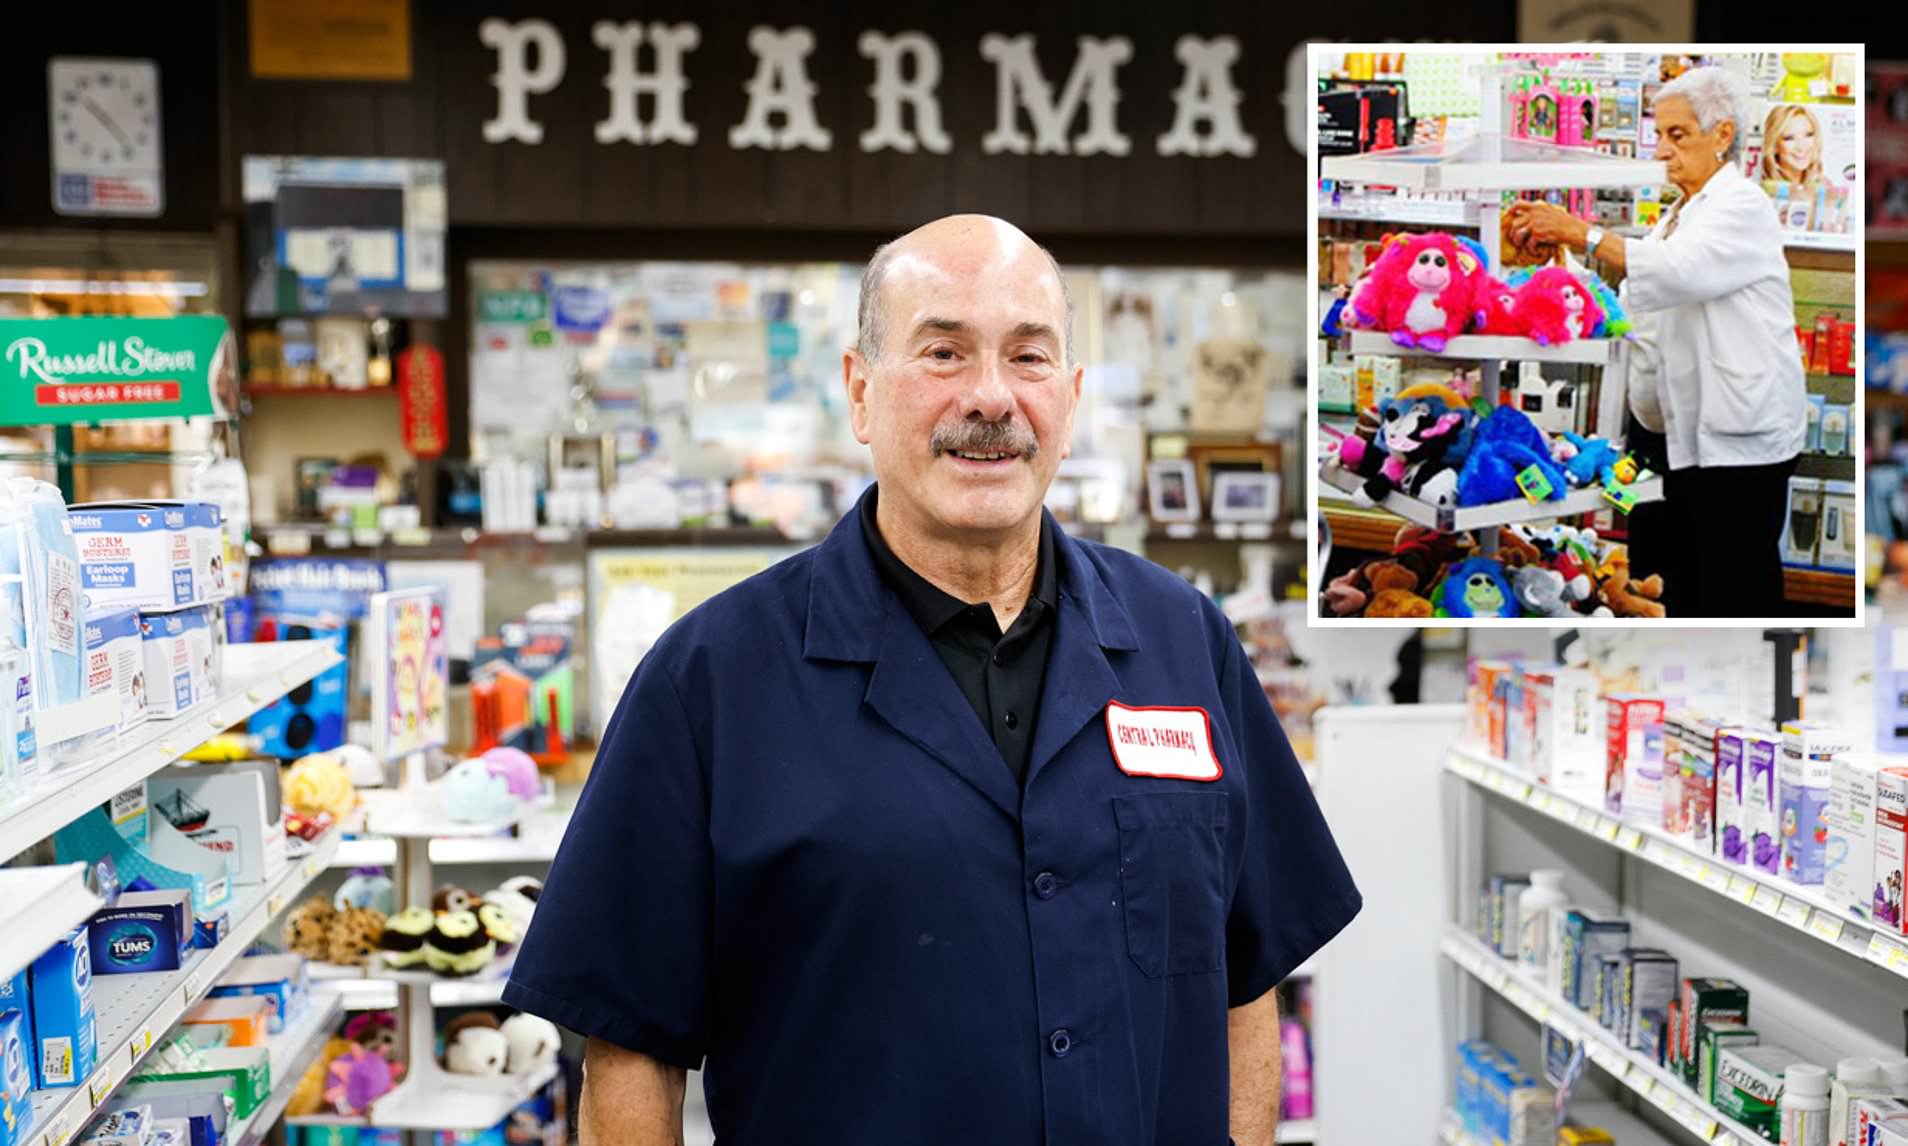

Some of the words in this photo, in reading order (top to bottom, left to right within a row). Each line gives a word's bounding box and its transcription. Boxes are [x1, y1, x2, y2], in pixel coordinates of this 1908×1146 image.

[6, 336, 122, 384] Russell
[120, 335, 196, 377] Stover
[56, 385, 119, 403] SUGAR
[123, 383, 164, 401] FREE
[88, 536, 123, 548] GERM
[86, 564, 128, 576] Earloop
[91, 573, 125, 583] Masks
[1117, 723, 1155, 748] CENTRAL
[1152, 727, 1198, 757] PHARMACY
[113, 941, 151, 954] TUMS
